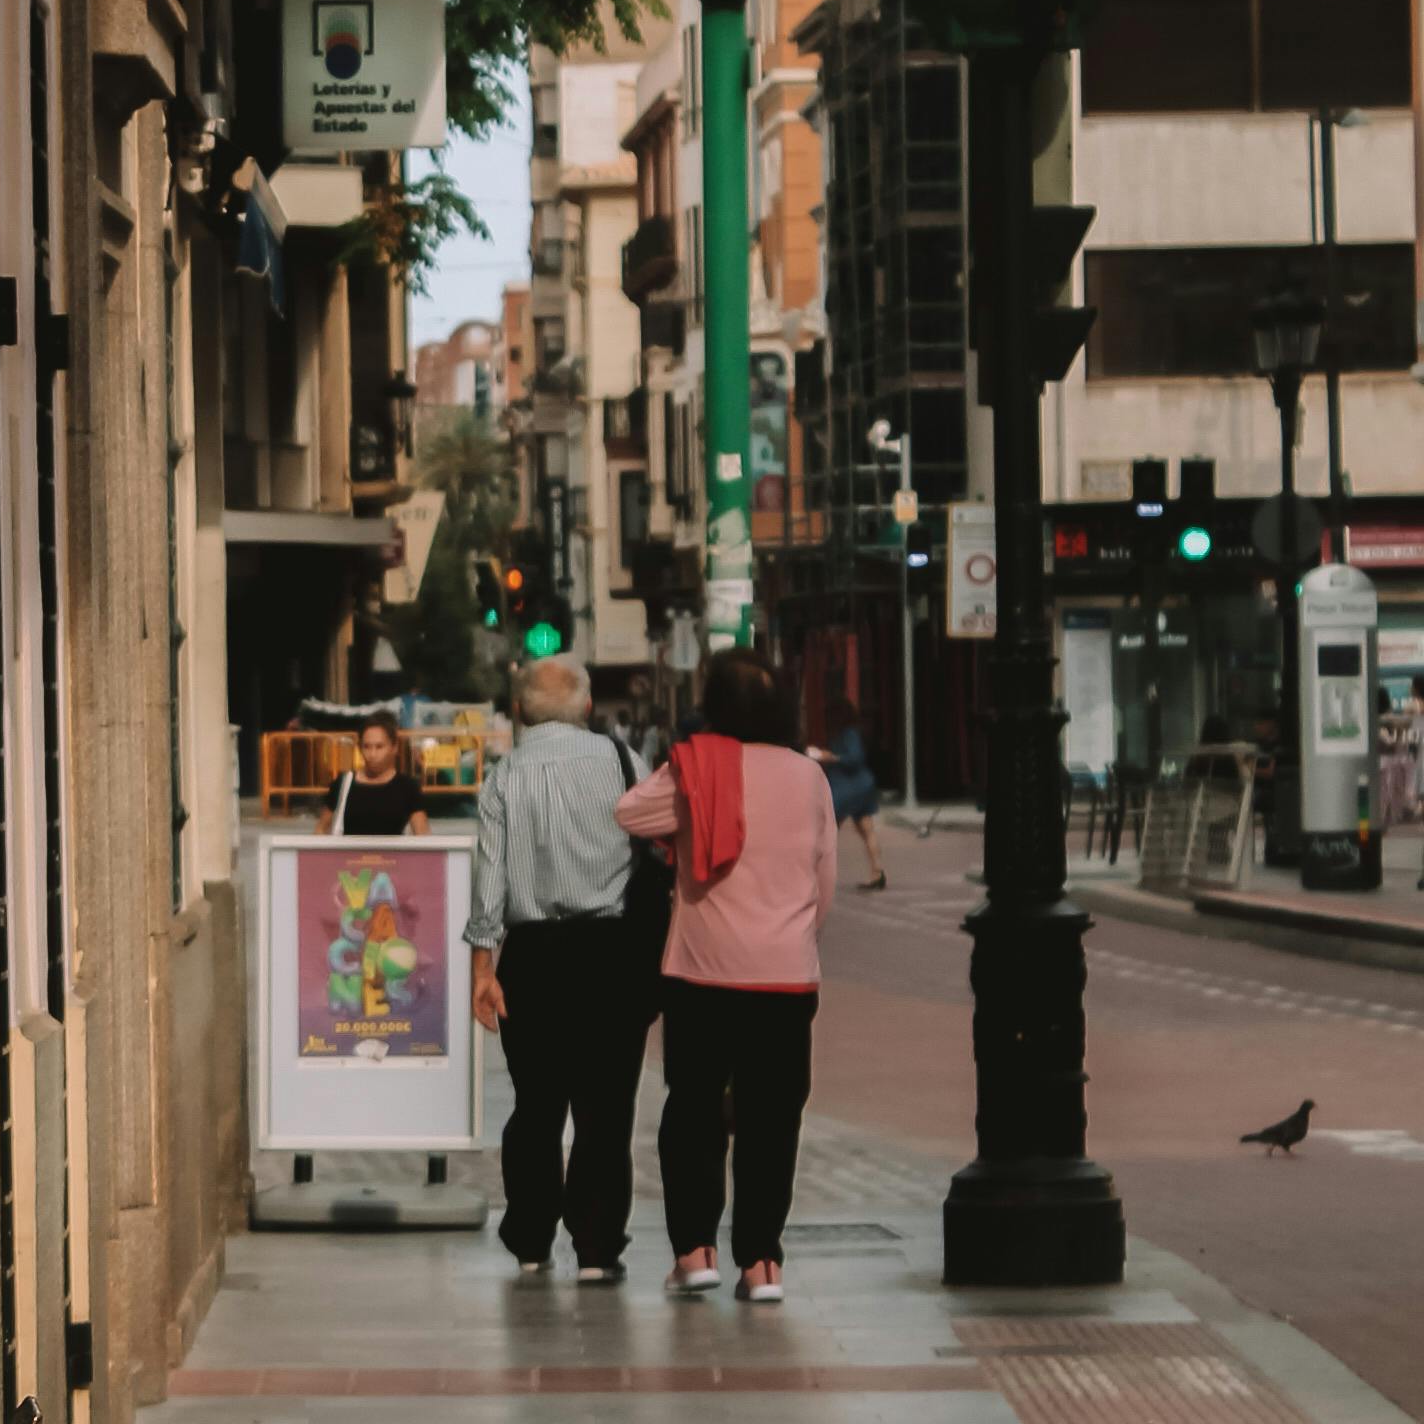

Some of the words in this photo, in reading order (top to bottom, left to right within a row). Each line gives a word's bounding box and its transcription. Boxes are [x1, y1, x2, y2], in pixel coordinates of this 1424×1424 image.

[383, 84, 391, 99] y
[314, 101, 387, 118] Apuestas
[392, 99, 416, 114] del
[313, 118, 368, 133] Estado
